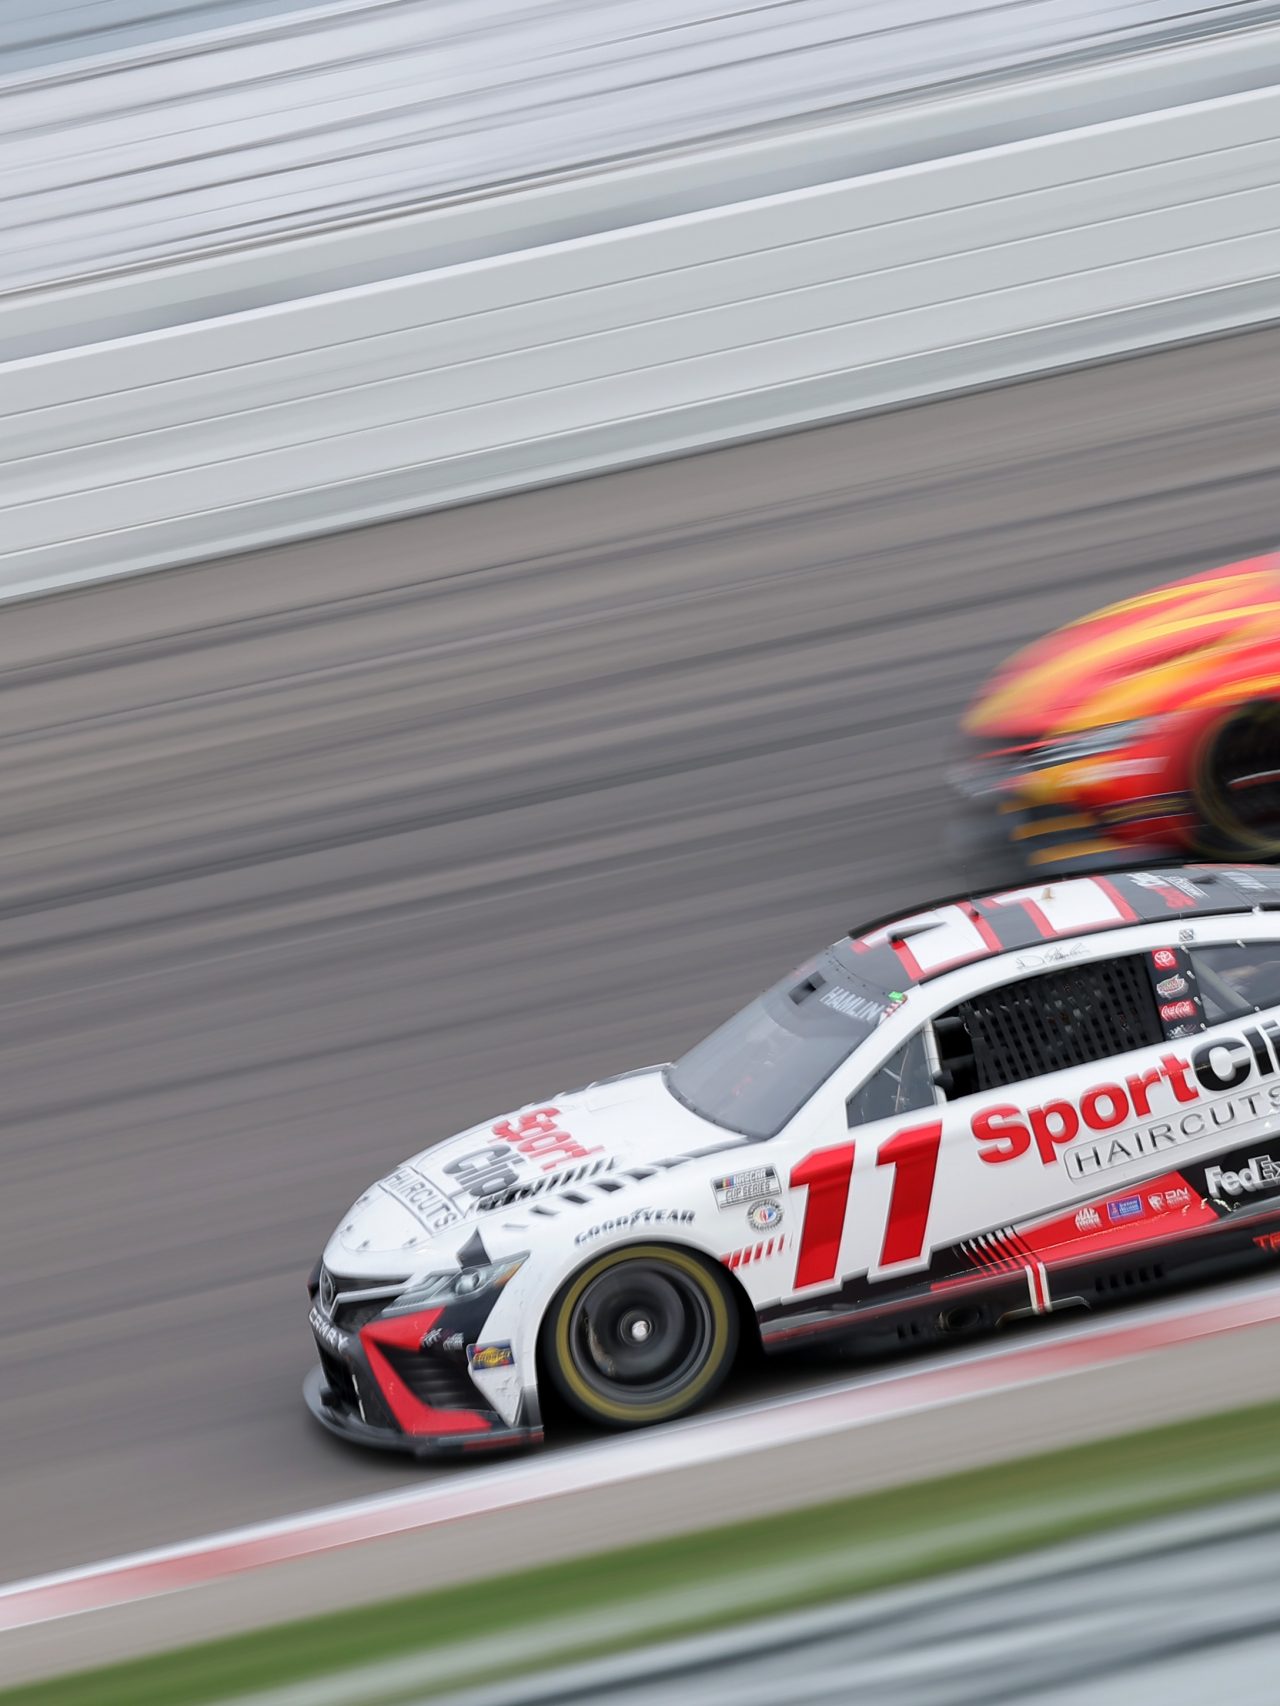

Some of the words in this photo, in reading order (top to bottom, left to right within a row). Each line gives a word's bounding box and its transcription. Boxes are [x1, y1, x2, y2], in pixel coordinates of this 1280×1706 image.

[820, 986, 886, 1021] HAMLIN
[487, 1107, 605, 1171] Sport
[384, 1168, 458, 1229] HAIRCUTS
[574, 1208, 697, 1246] GOODYEAR
[788, 1118, 943, 1291] 11
